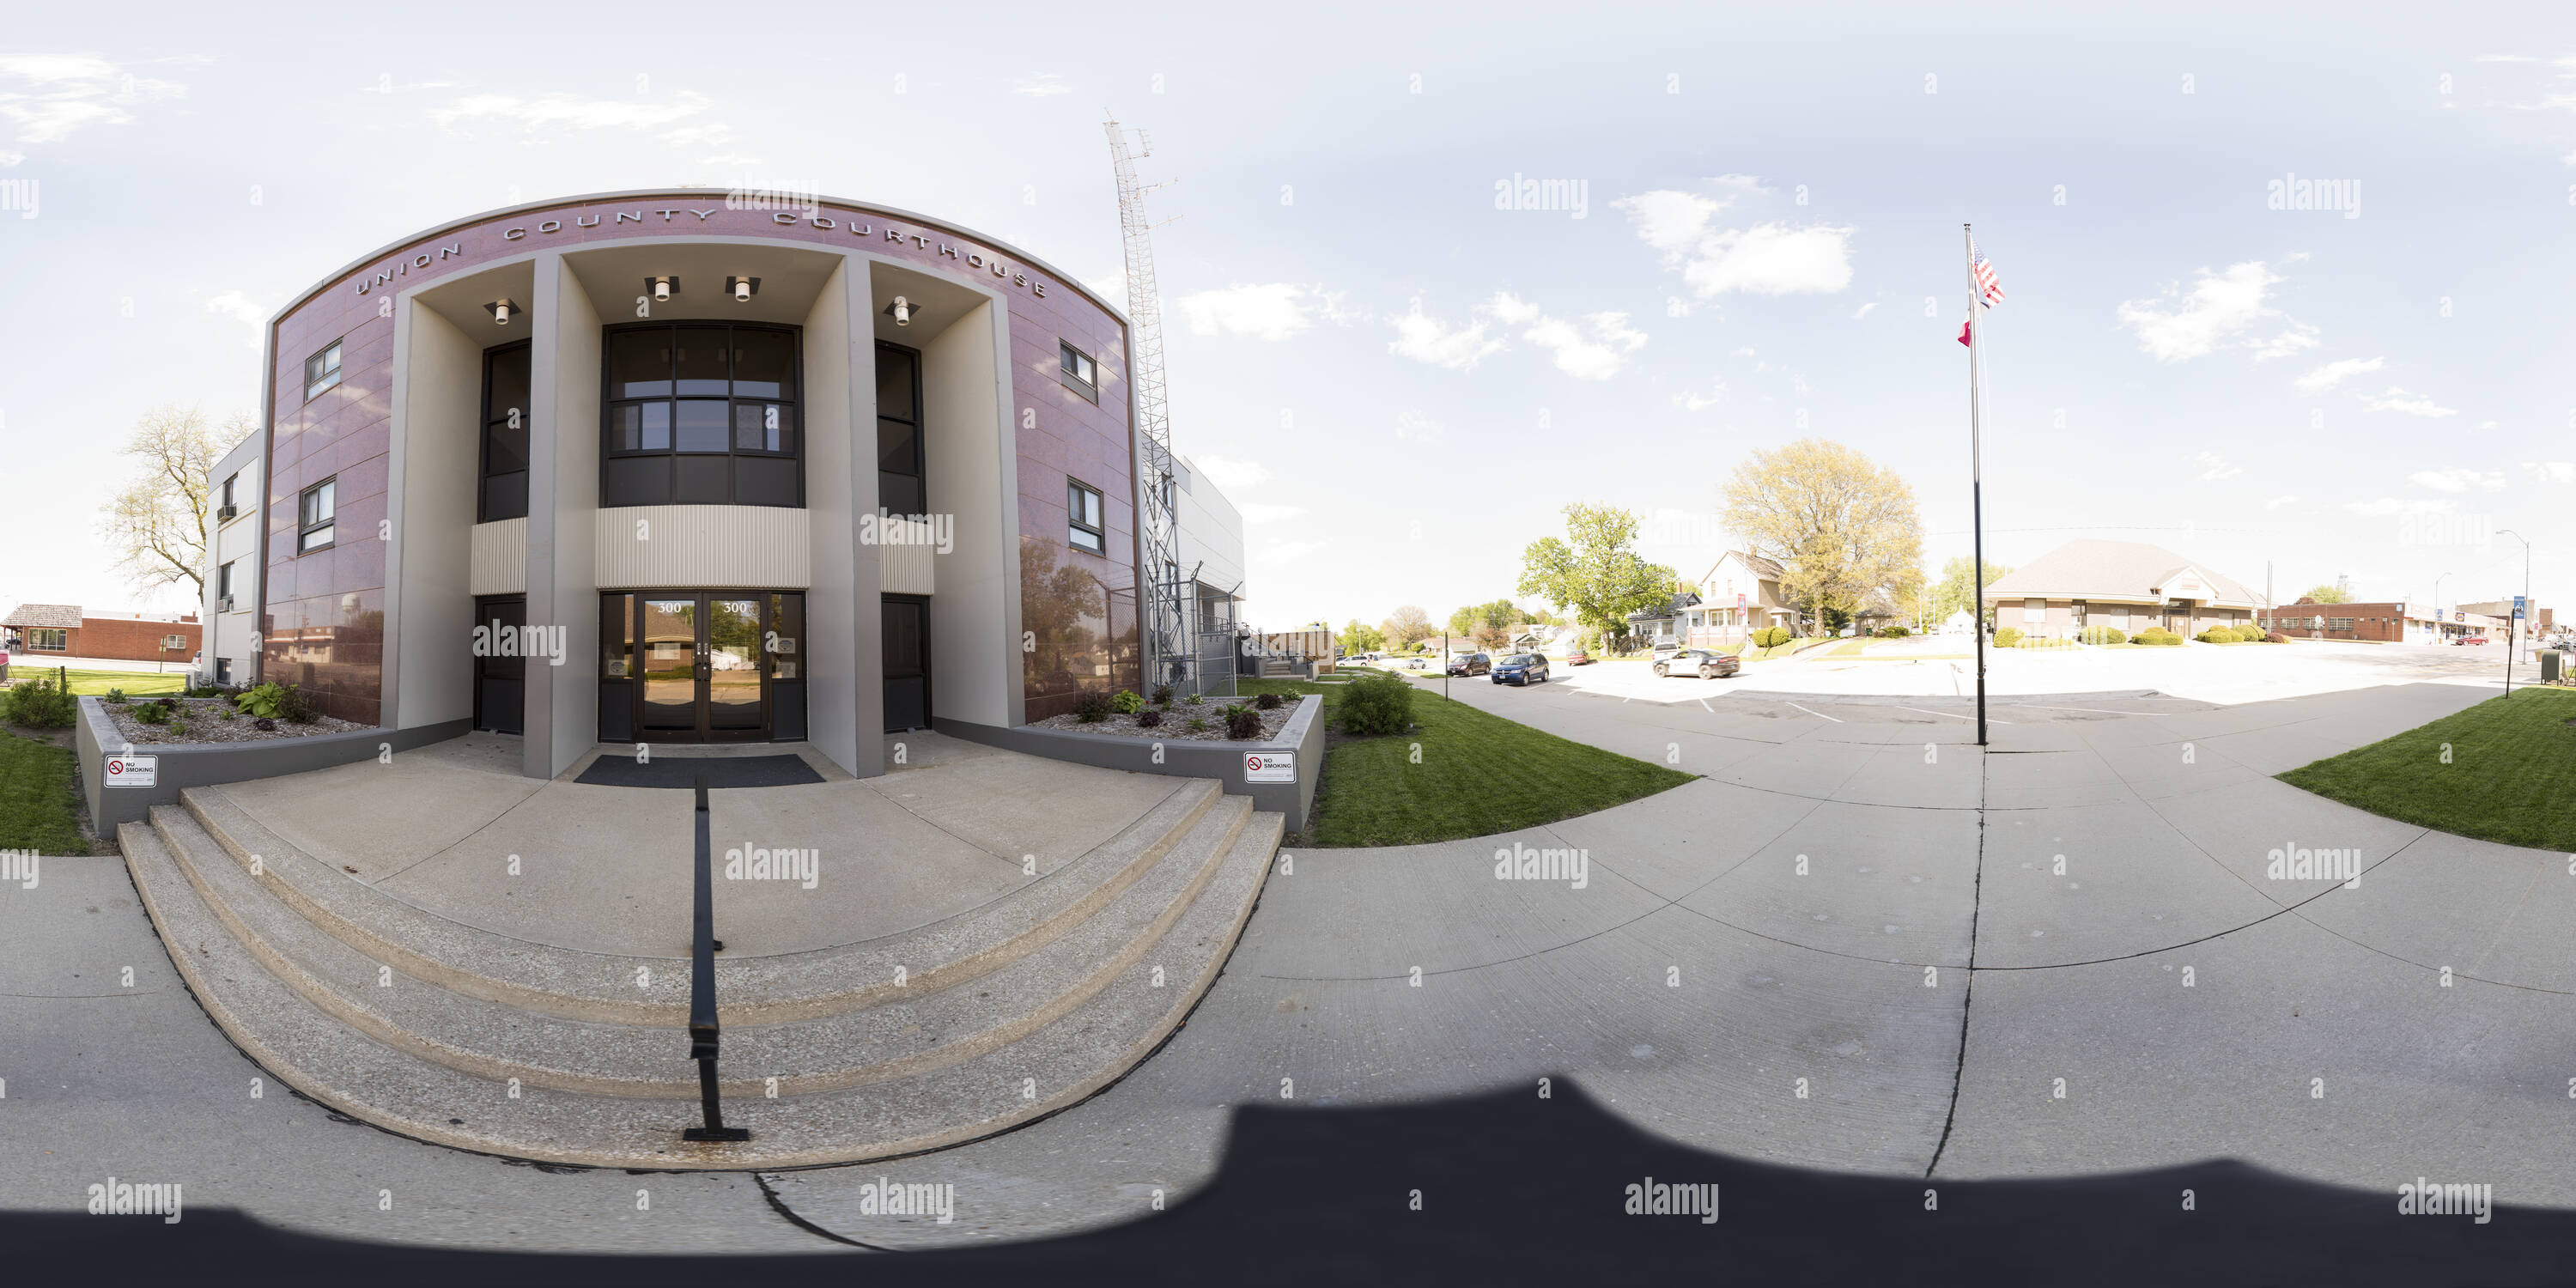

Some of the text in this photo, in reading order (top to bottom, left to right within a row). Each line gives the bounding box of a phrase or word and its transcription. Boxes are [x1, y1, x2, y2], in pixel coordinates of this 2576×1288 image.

[356, 208, 1048, 300] UNION COUNTY COURTHOUSE
[658, 602, 682, 613] 300
[723, 602, 747, 613] 300
